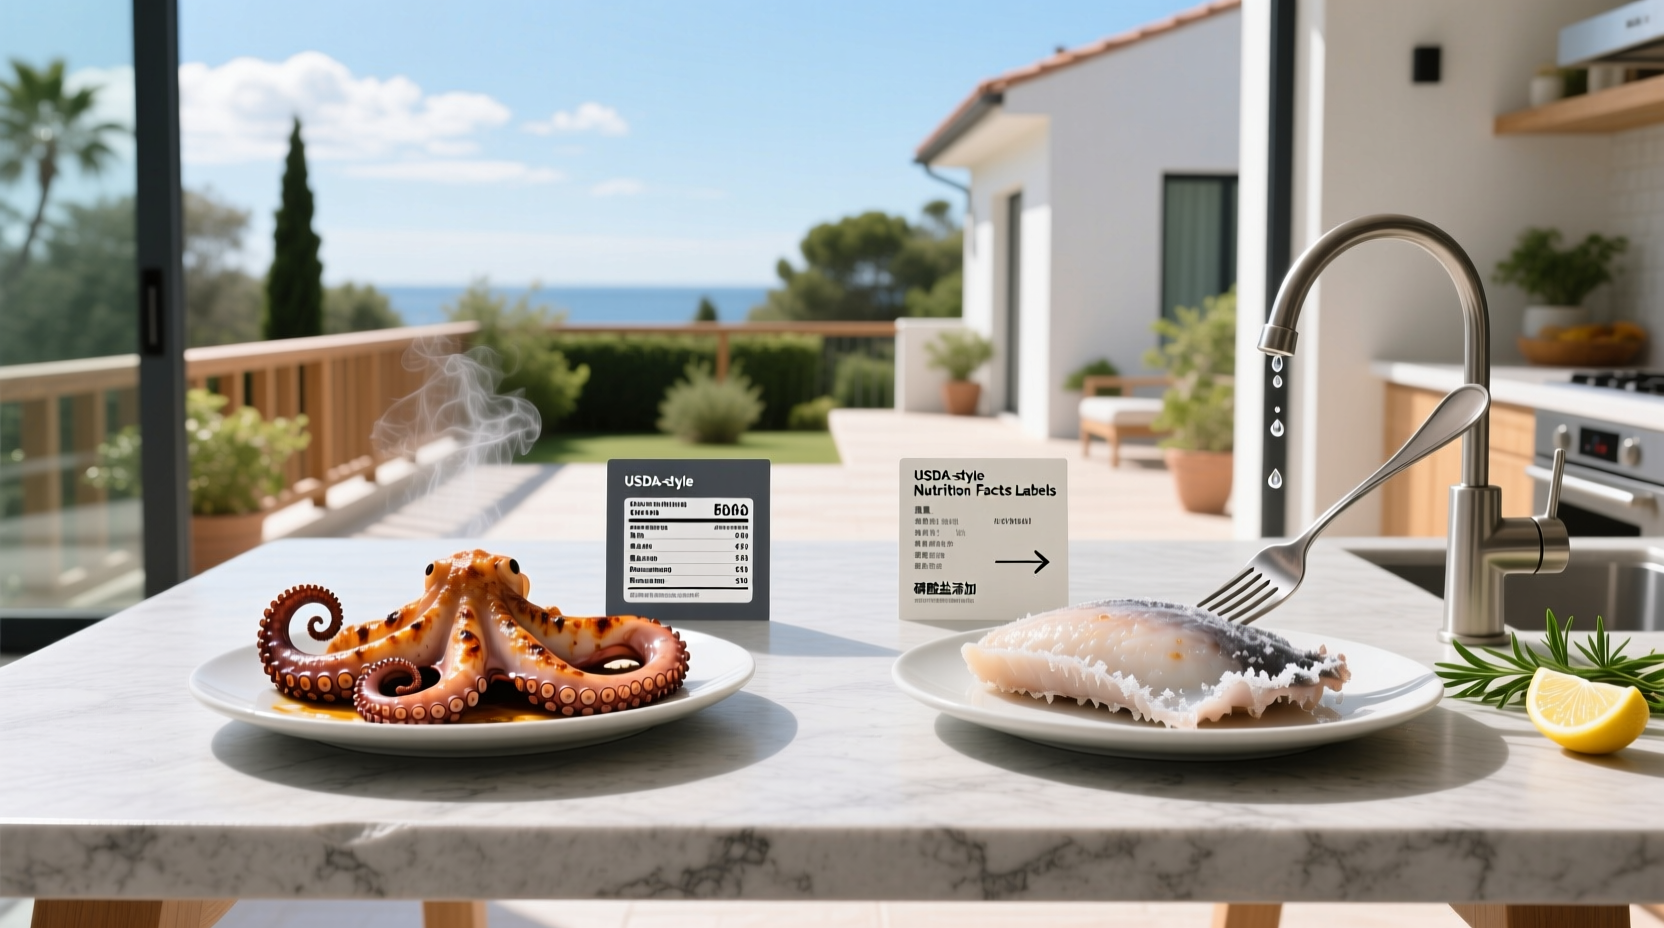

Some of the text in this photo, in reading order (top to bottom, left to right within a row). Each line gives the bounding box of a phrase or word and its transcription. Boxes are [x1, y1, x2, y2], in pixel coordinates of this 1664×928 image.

[914, 483, 1057, 497] Nutrition Facts Labels
